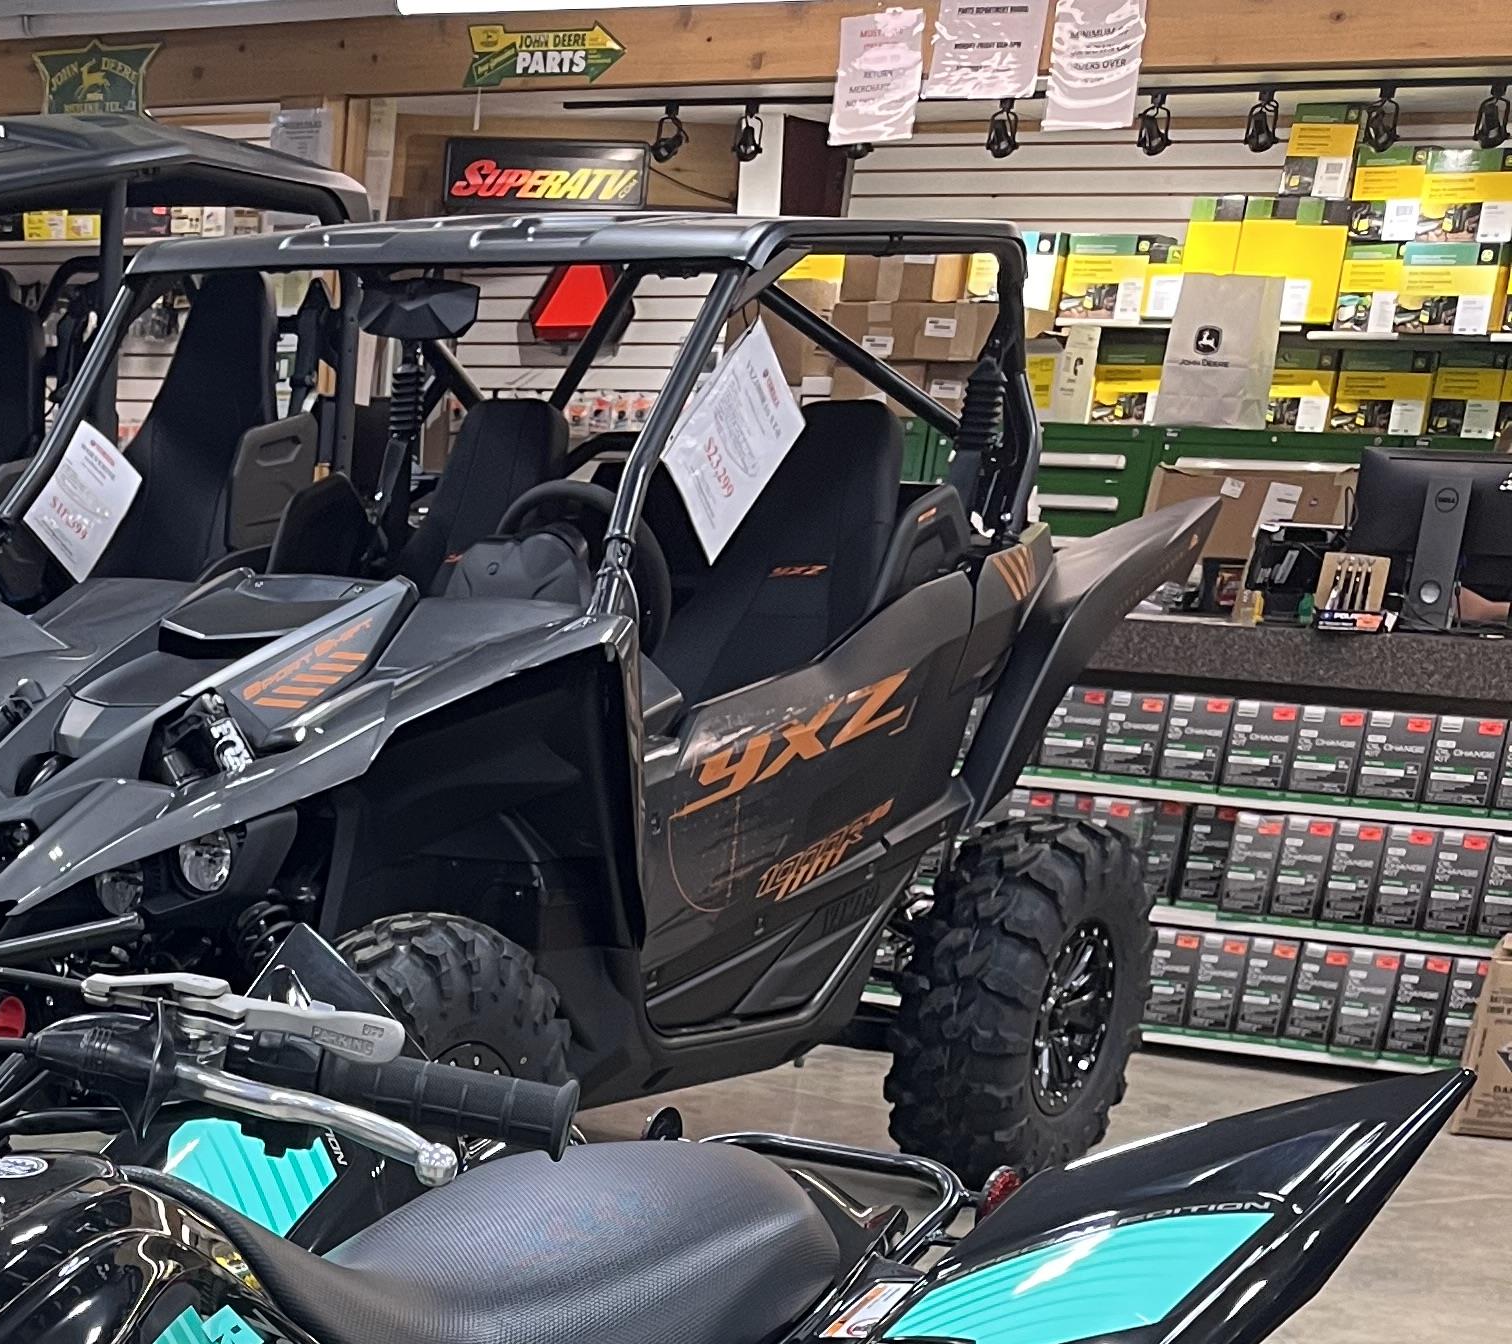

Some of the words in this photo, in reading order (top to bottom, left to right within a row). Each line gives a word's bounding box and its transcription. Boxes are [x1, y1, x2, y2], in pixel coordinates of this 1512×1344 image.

[519, 34, 549, 49] JOHN
[553, 33, 587, 48] DEERE
[101, 57, 139, 85] DEERE
[516, 50, 587, 74] PARTS
[1383, 743, 1425, 753] CHANGE
[1453, 749, 1495, 759] CHANGE
[311, 1025, 375, 1056] PARKING
[1116, 1201, 1272, 1226] EDITION
